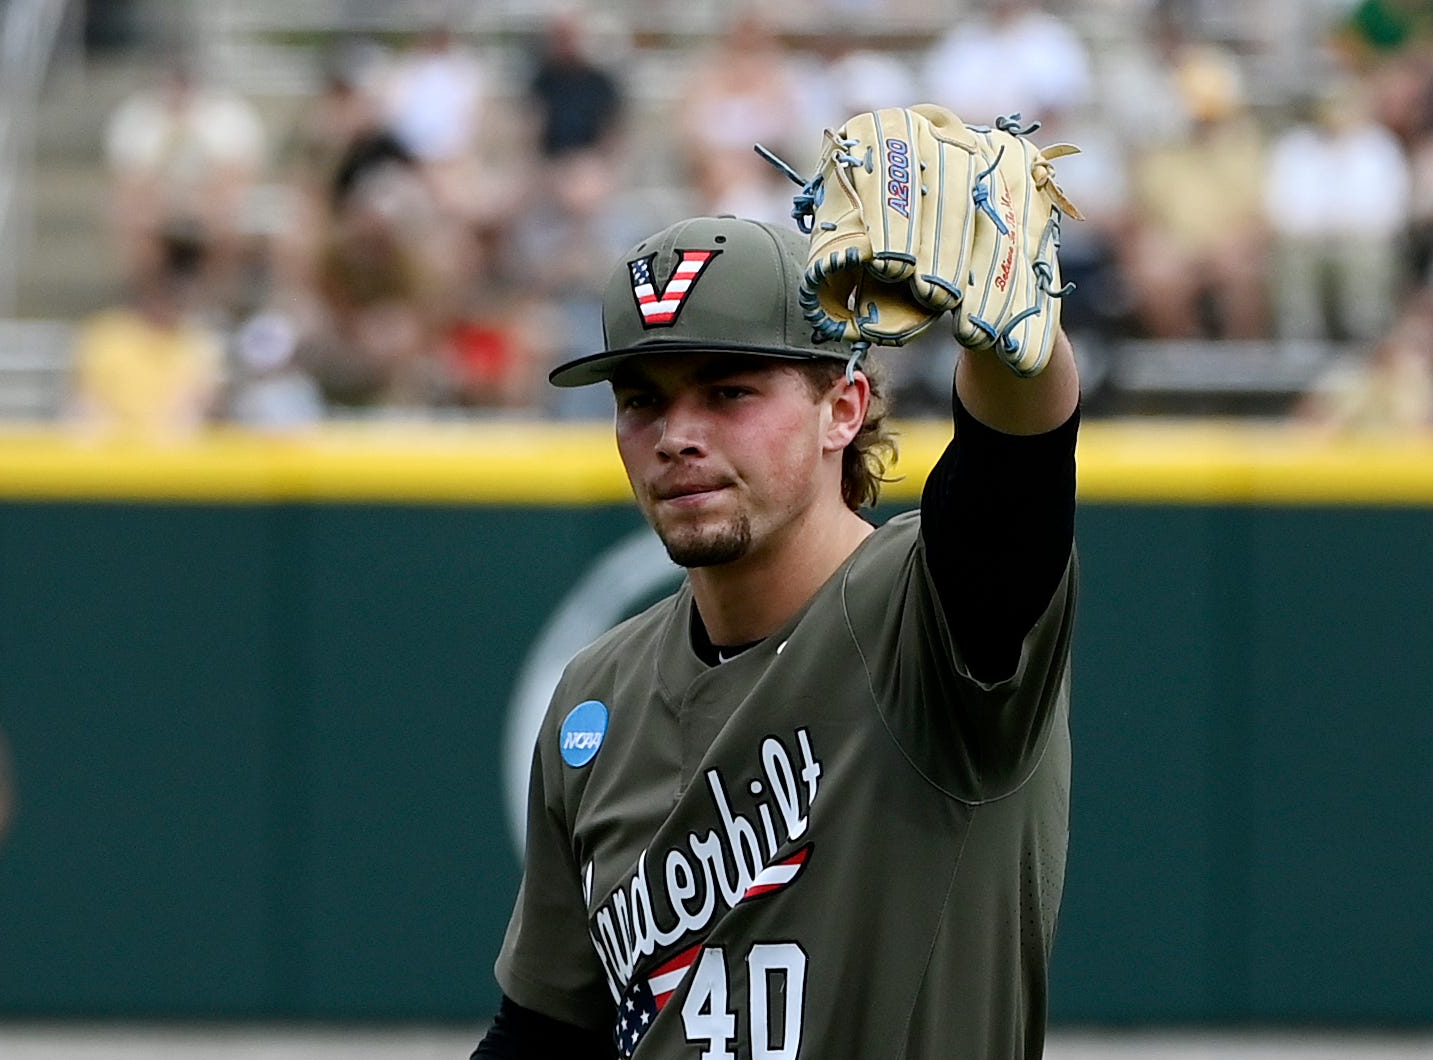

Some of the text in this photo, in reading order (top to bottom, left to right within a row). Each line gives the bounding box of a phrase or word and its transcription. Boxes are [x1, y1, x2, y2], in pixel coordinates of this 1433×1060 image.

[886, 138, 909, 219] A2000
[627, 249, 723, 330] V
[563, 731, 604, 750] NCAA
[582, 727, 822, 1007] nderbilt
